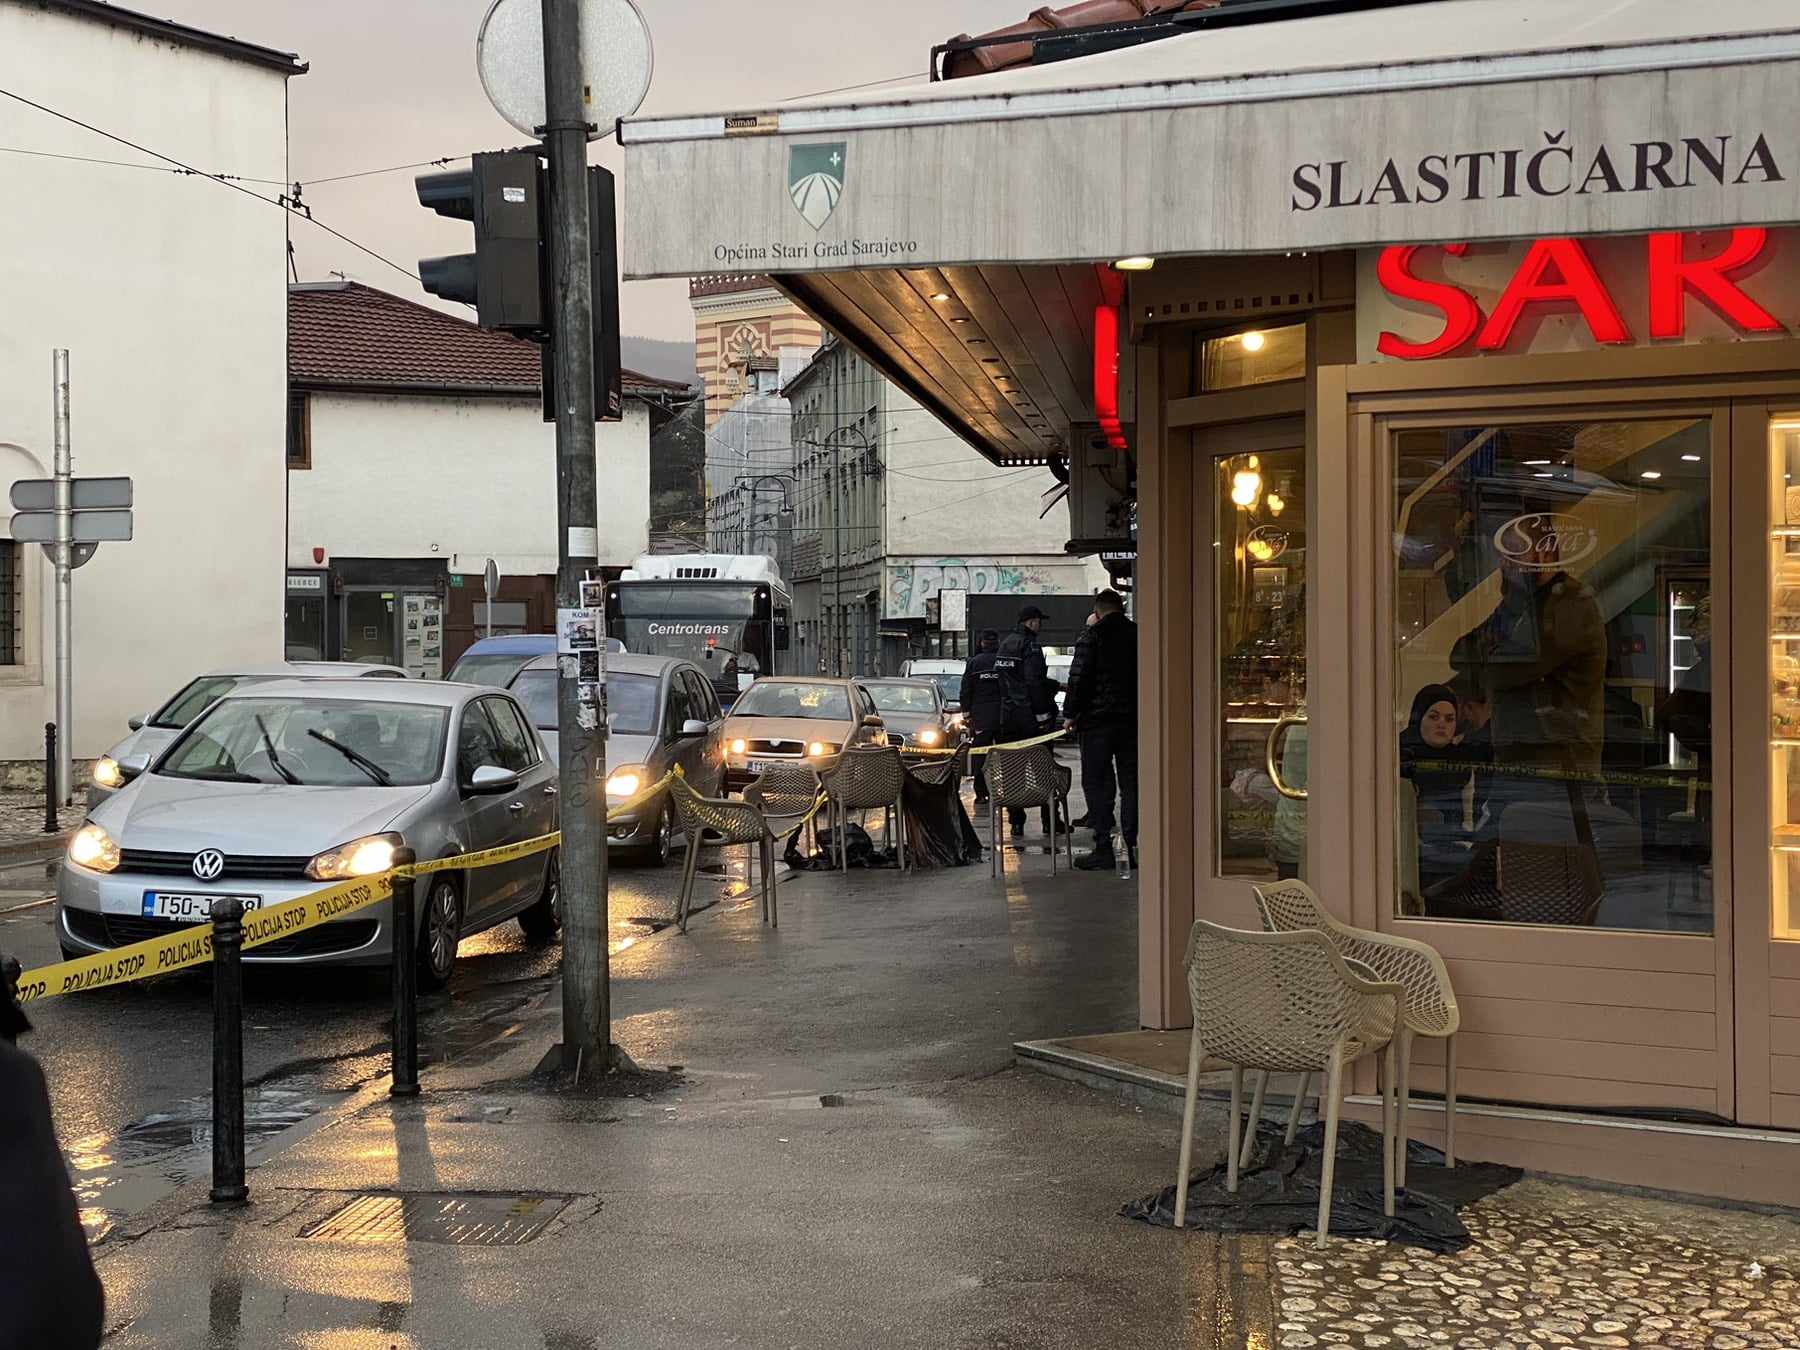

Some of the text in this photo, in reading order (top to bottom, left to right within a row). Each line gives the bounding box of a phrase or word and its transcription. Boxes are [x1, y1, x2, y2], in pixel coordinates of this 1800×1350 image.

[1291, 130, 1786, 212] SLASTIČARNA
[714, 237, 917, 263] Općina Stari Grad Sarajevo
[648, 622, 729, 635] Centrotrans
[241, 914, 283, 945] POLICIJA
[284, 906, 307, 930] STOP
[316, 893, 353, 921] POLICIJA
[350, 884, 372, 906] STOP
[16, 981, 46, 1001] TOP
[62, 963, 113, 993] POLICIJA
[114, 953, 145, 980] STOP
[157, 937, 203, 969] POLICIJA
